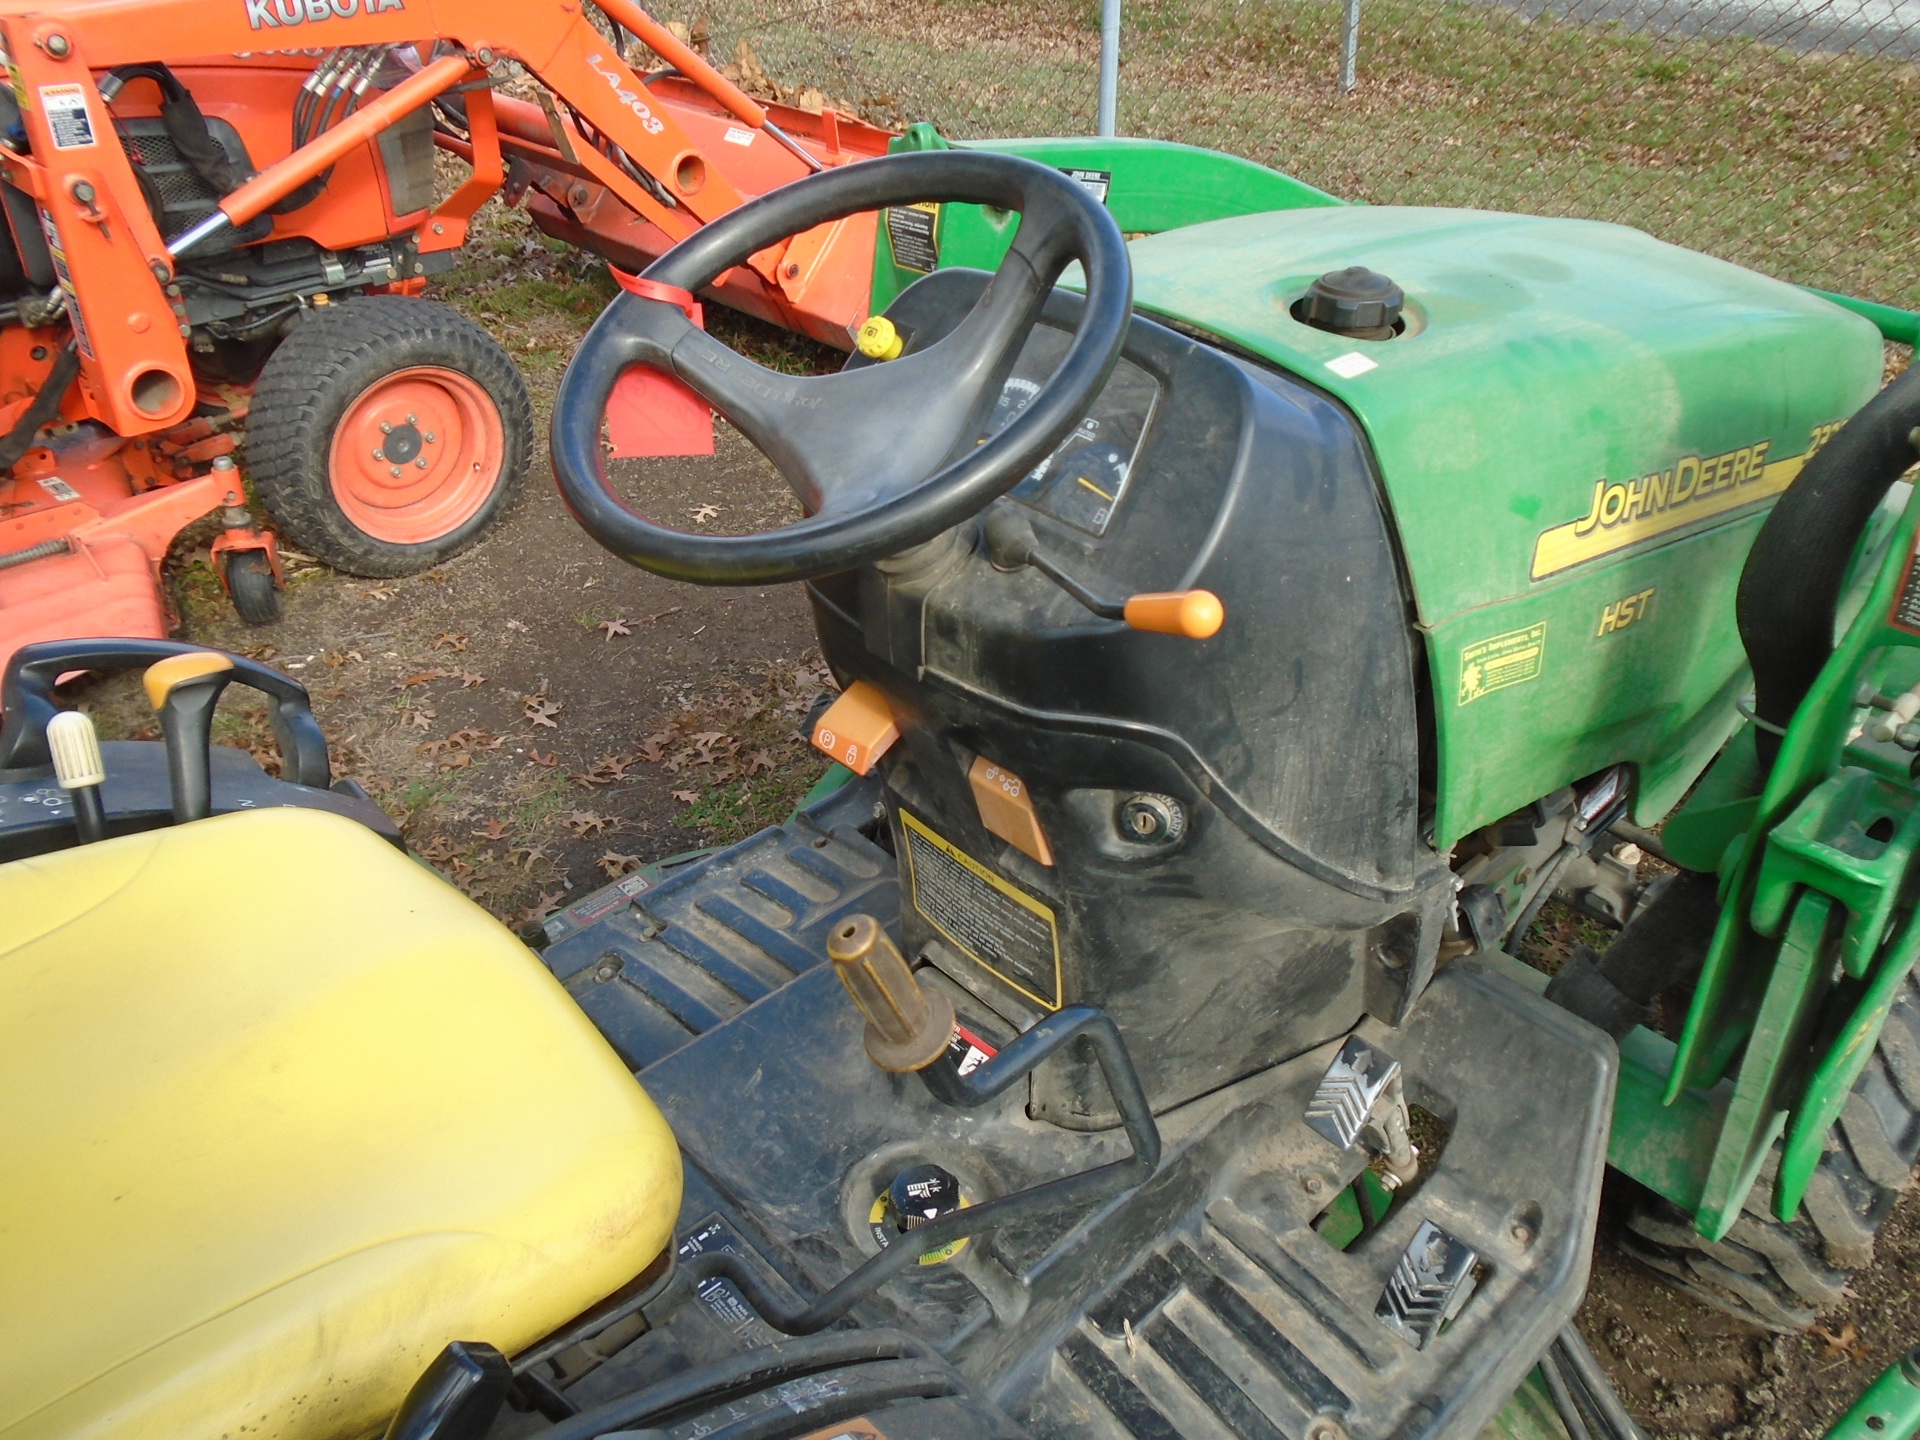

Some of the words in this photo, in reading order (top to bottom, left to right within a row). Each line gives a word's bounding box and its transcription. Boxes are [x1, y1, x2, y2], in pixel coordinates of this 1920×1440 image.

[587, 54, 664, 134] LA403
[702, 350, 774, 399] DEERE
[1077, 426, 1096, 441] RATED
[1575, 478, 1671, 536] JOHN
[1669, 439, 1771, 509] DEERE
[1597, 587, 1656, 637] HST
[1170, 806, 1184, 838] START
[957, 853, 996, 884] CAUTION
